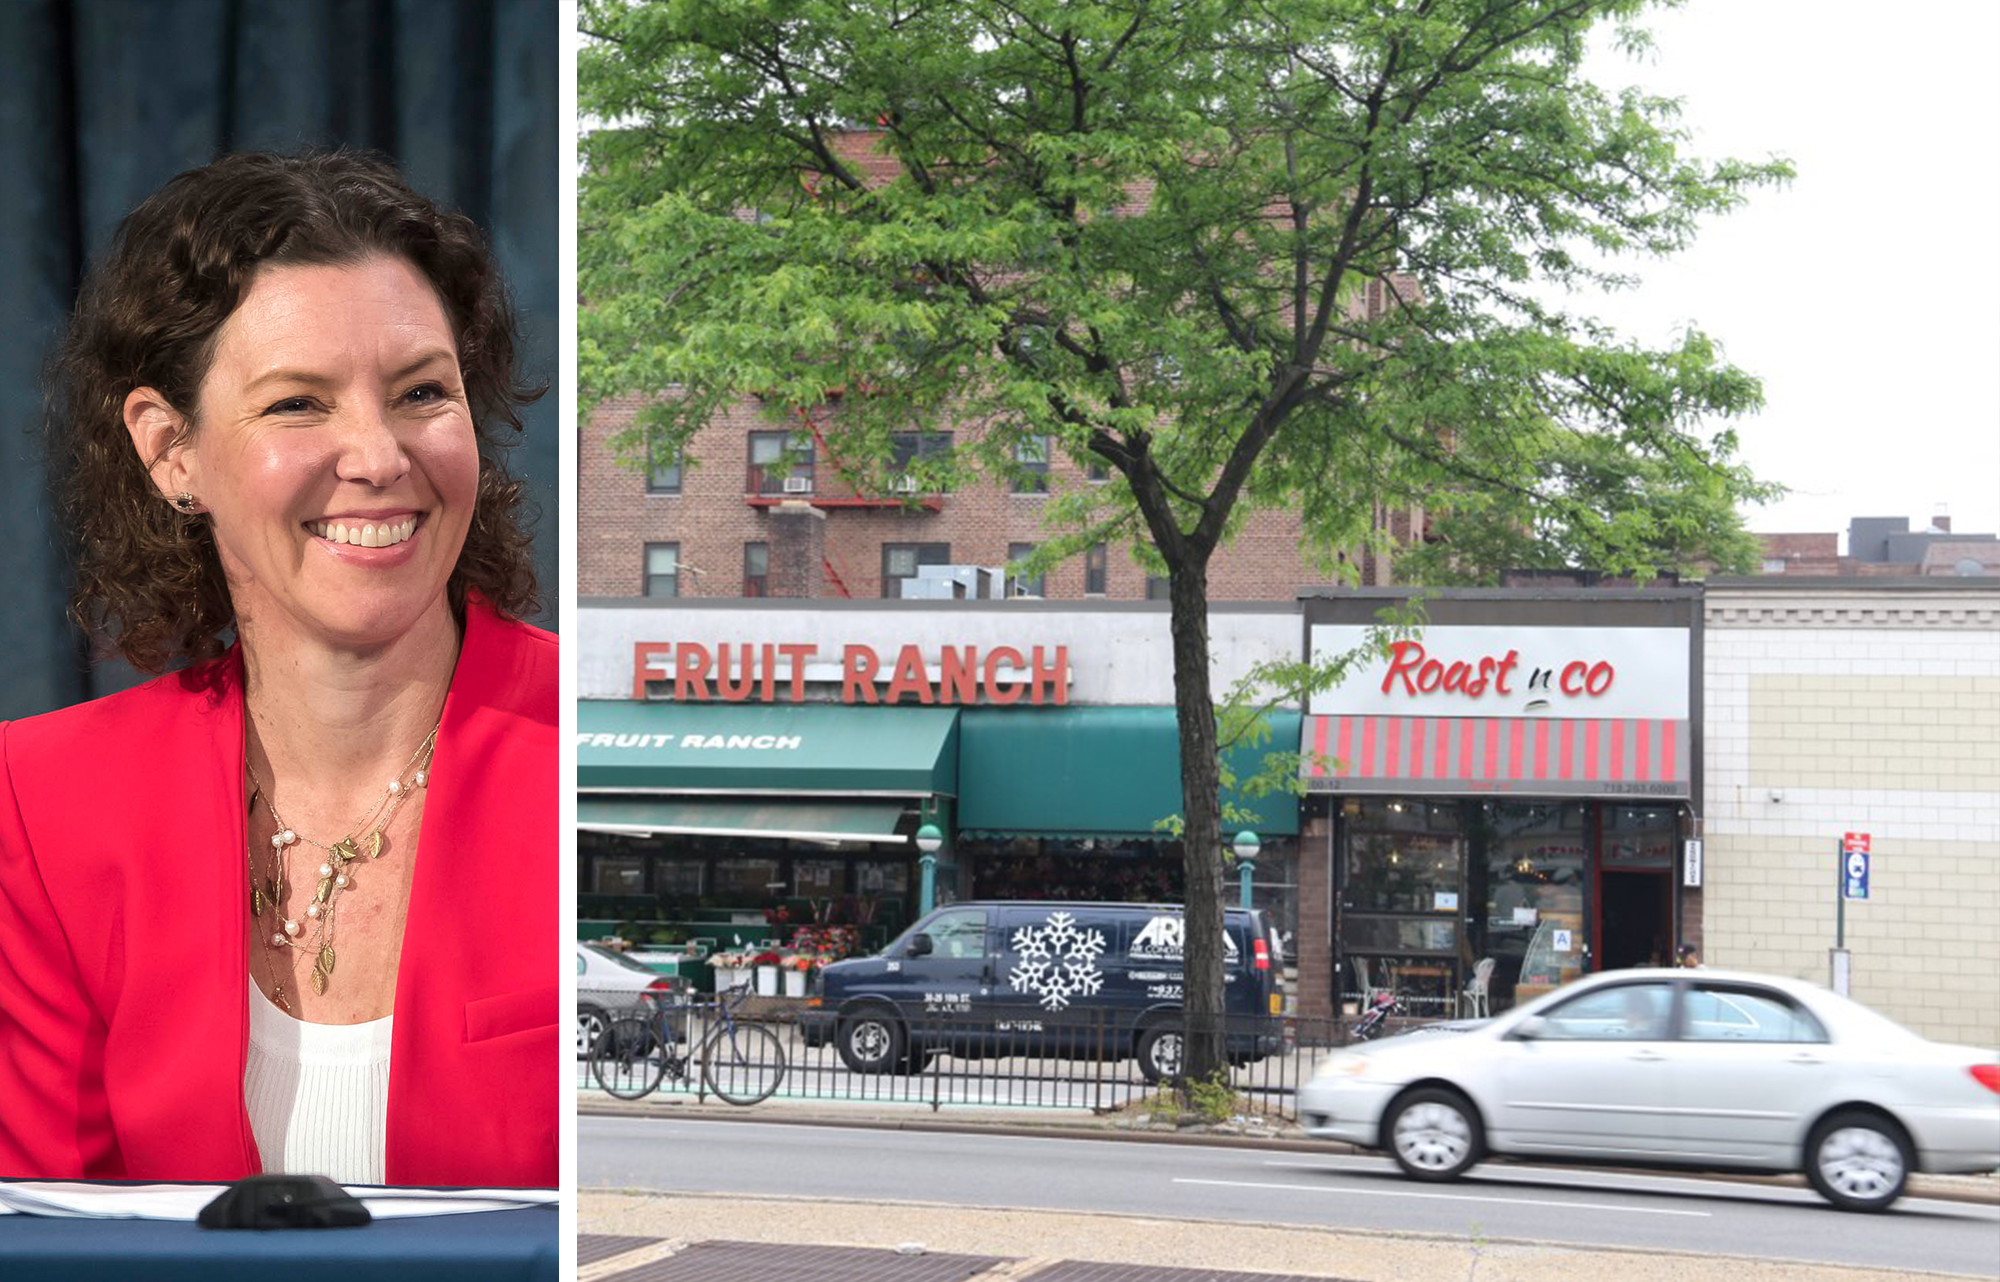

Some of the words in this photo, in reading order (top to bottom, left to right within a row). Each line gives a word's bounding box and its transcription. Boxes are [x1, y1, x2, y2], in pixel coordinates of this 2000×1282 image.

[632, 642, 817, 700] FRUIT
[841, 644, 1068, 705] RANCH
[1381, 640, 1518, 698] Roast
[1528, 665, 1553, 691] n
[577, 733, 674, 748] FRUIT
[680, 735, 803, 749] RANCH
[1557, 932, 1568, 945] A
